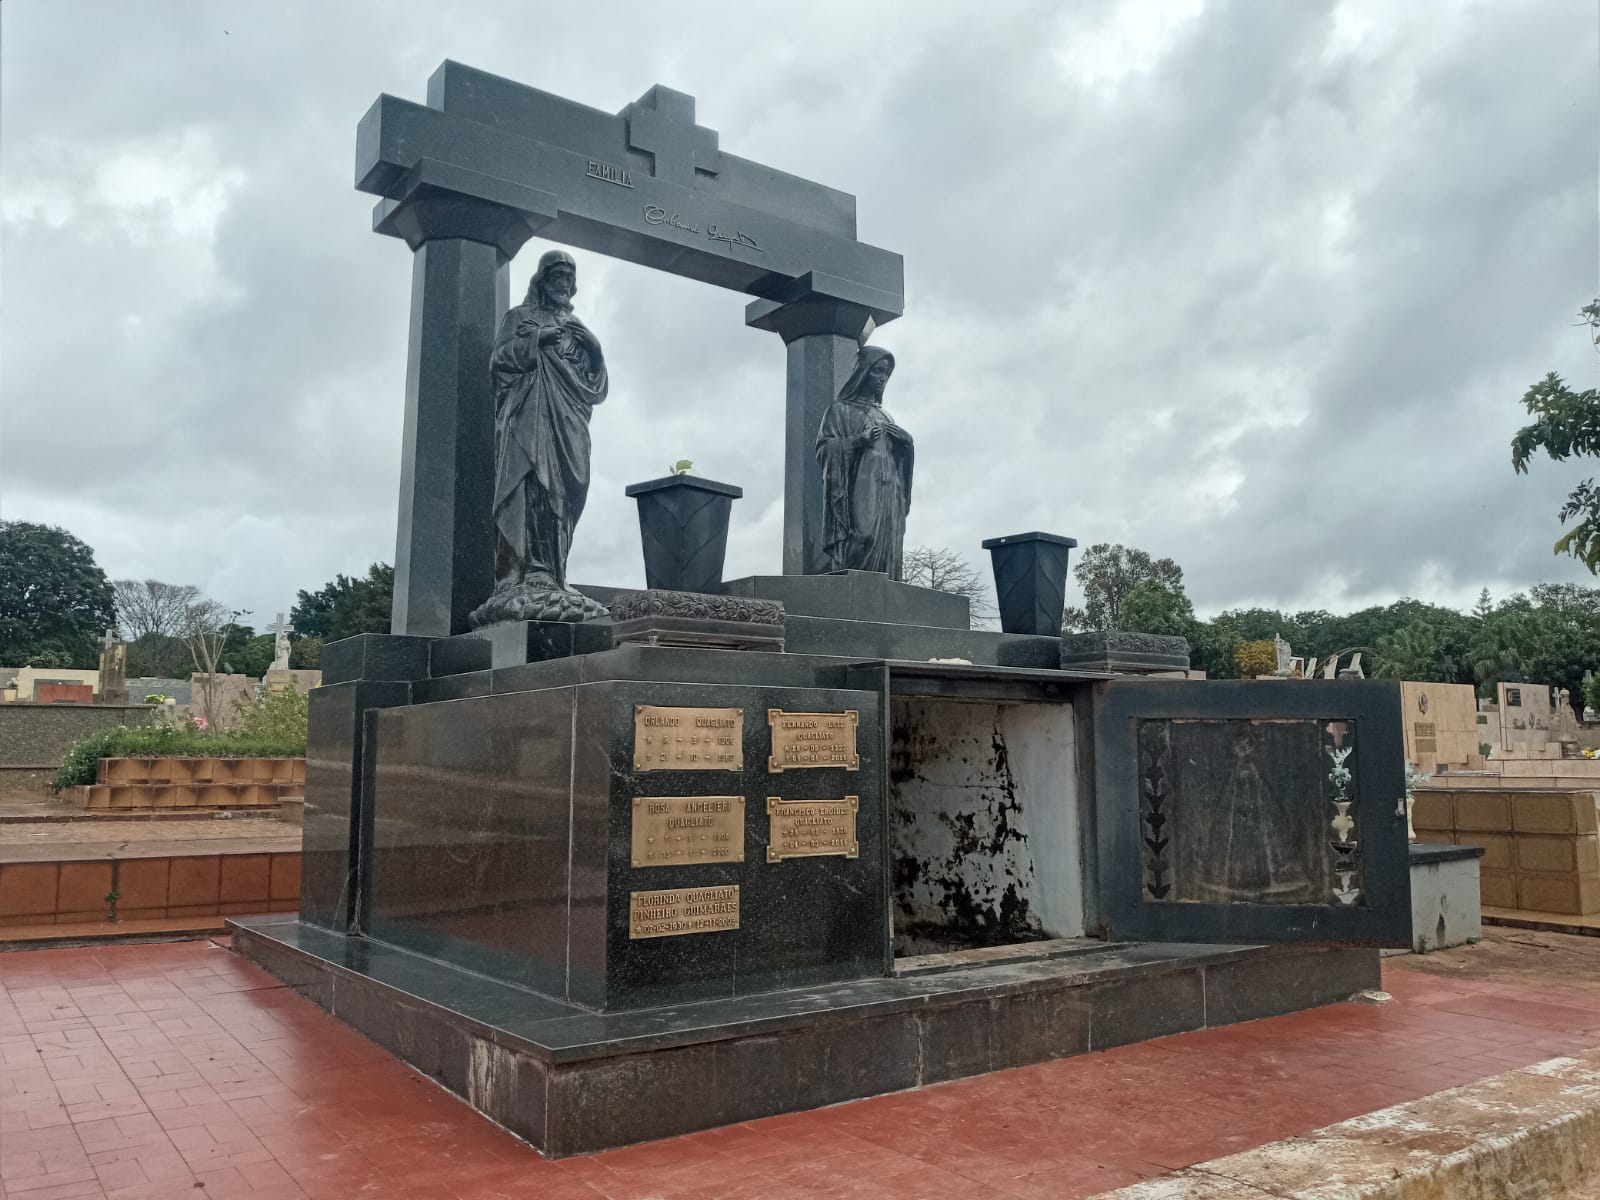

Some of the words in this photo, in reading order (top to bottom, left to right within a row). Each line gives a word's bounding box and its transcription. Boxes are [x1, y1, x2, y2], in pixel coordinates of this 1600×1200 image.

[587, 161, 634, 188] FAMILIA
[644, 715, 680, 727] ORLANDO
[696, 717, 736, 729] QUAGLIATO
[782, 720, 818, 729] FERNANDO
[797, 731, 835, 740] QUAGLIATO
[648, 802, 670, 815] ROSA
[775, 808, 815, 817] FRANCISCO
[668, 816, 713, 829] QUAGLIATO
[794, 817, 833, 826] QUAGLIATO
[637, 893, 681, 907] FLORINDA
[686, 889, 734, 903] QUAGLIATO
[633, 907, 677, 921] PINHEIRO
[684, 900, 737, 916] GUIMARÃES
